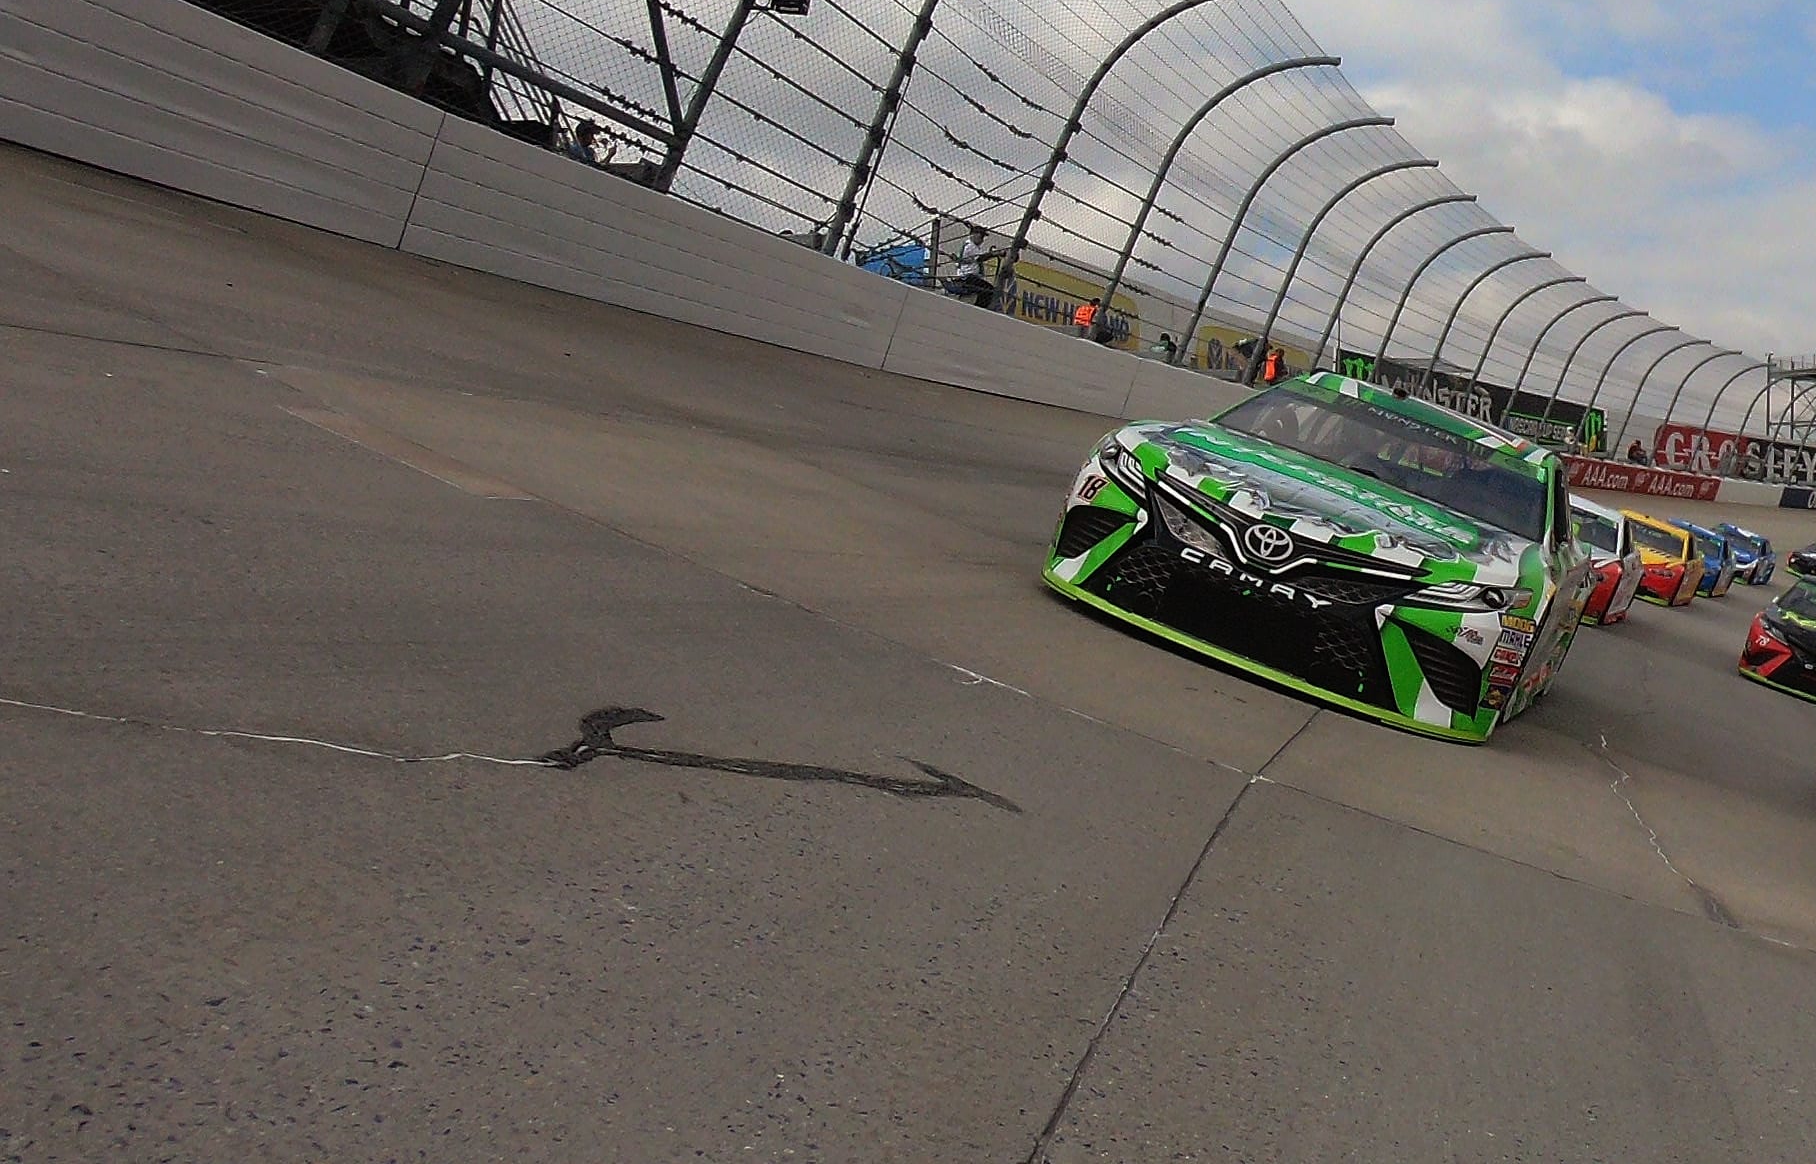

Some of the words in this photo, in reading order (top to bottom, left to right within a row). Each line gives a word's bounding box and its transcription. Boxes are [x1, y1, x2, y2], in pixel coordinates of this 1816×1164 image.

[1079, 475, 1108, 502] 18
[1581, 467, 1628, 490] AAA.com
[1647, 472, 1694, 498] AAA.com
